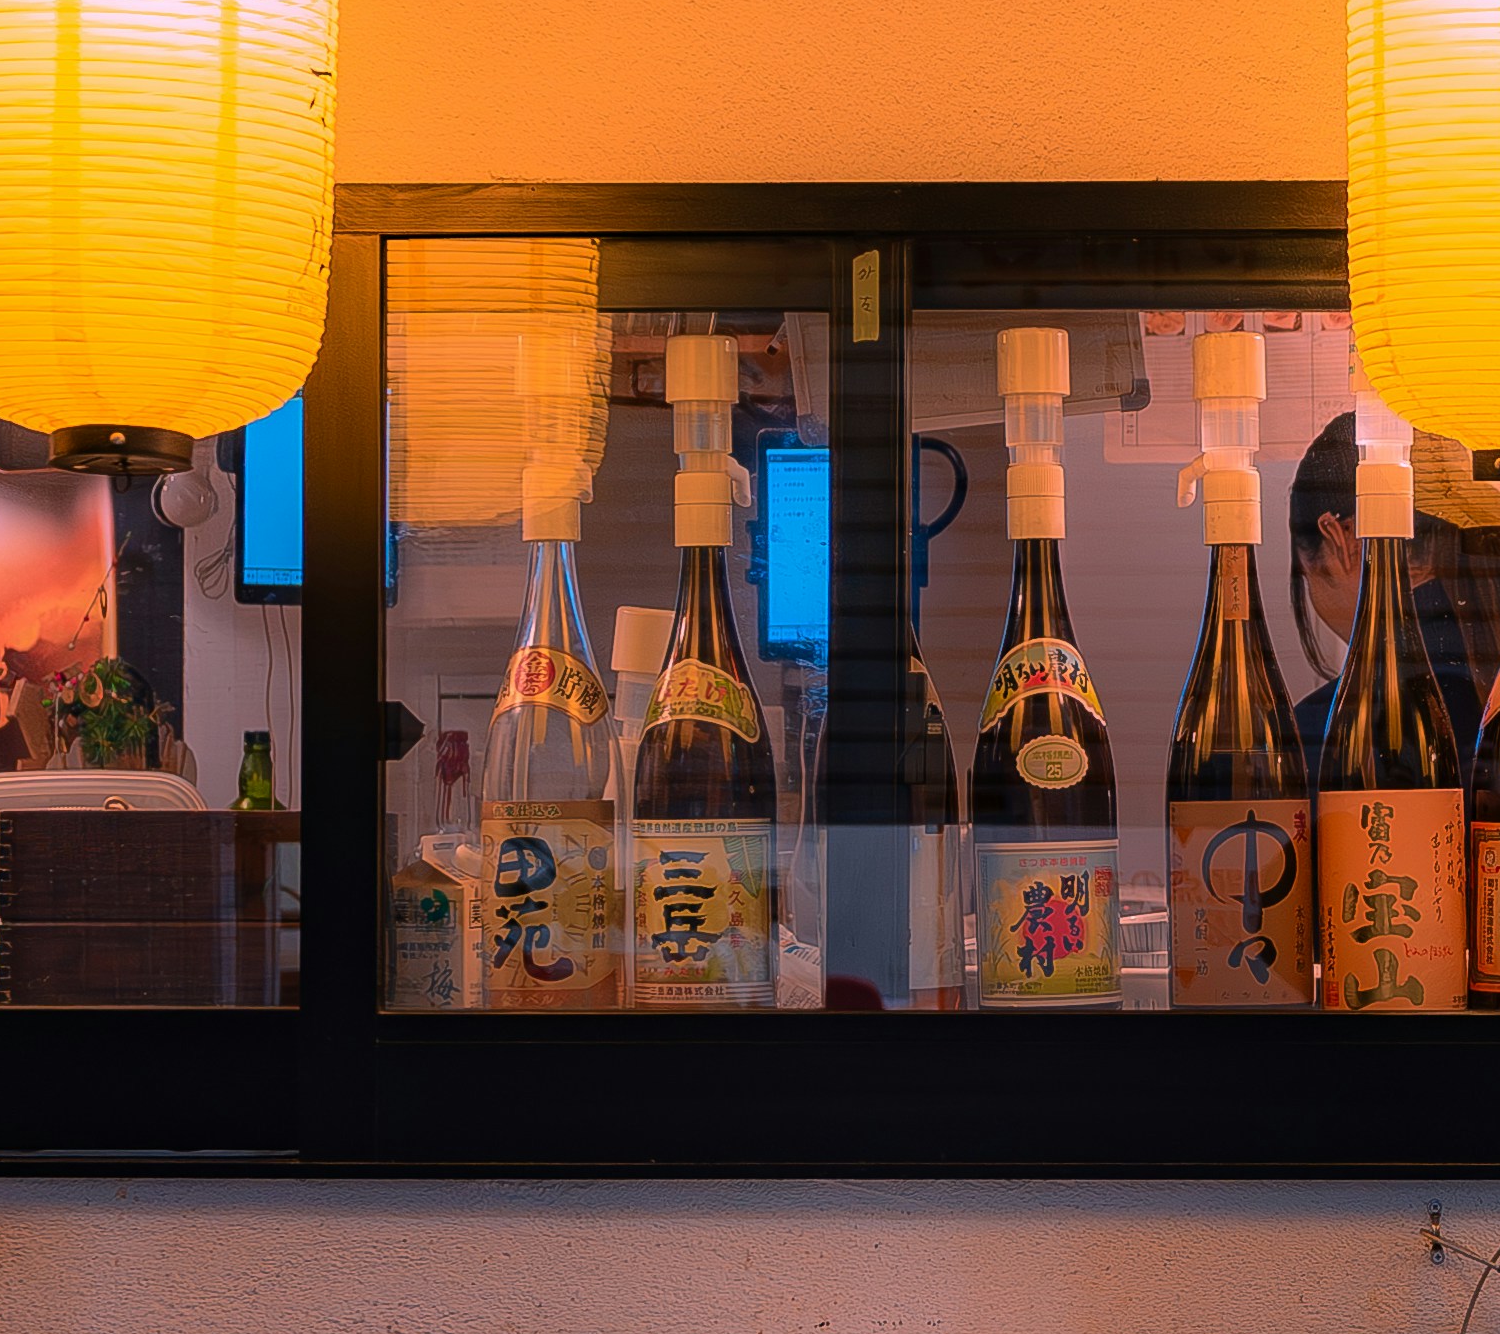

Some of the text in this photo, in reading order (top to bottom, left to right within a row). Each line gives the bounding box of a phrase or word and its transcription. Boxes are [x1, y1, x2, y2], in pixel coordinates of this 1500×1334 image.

[1046, 763, 1063, 779] 25
[494, 835, 576, 984] 田苑
[650, 849, 725, 964] 三岳
[1010, 880, 1056, 979] 農村
[1060, 870, 1091, 952] 明るい
